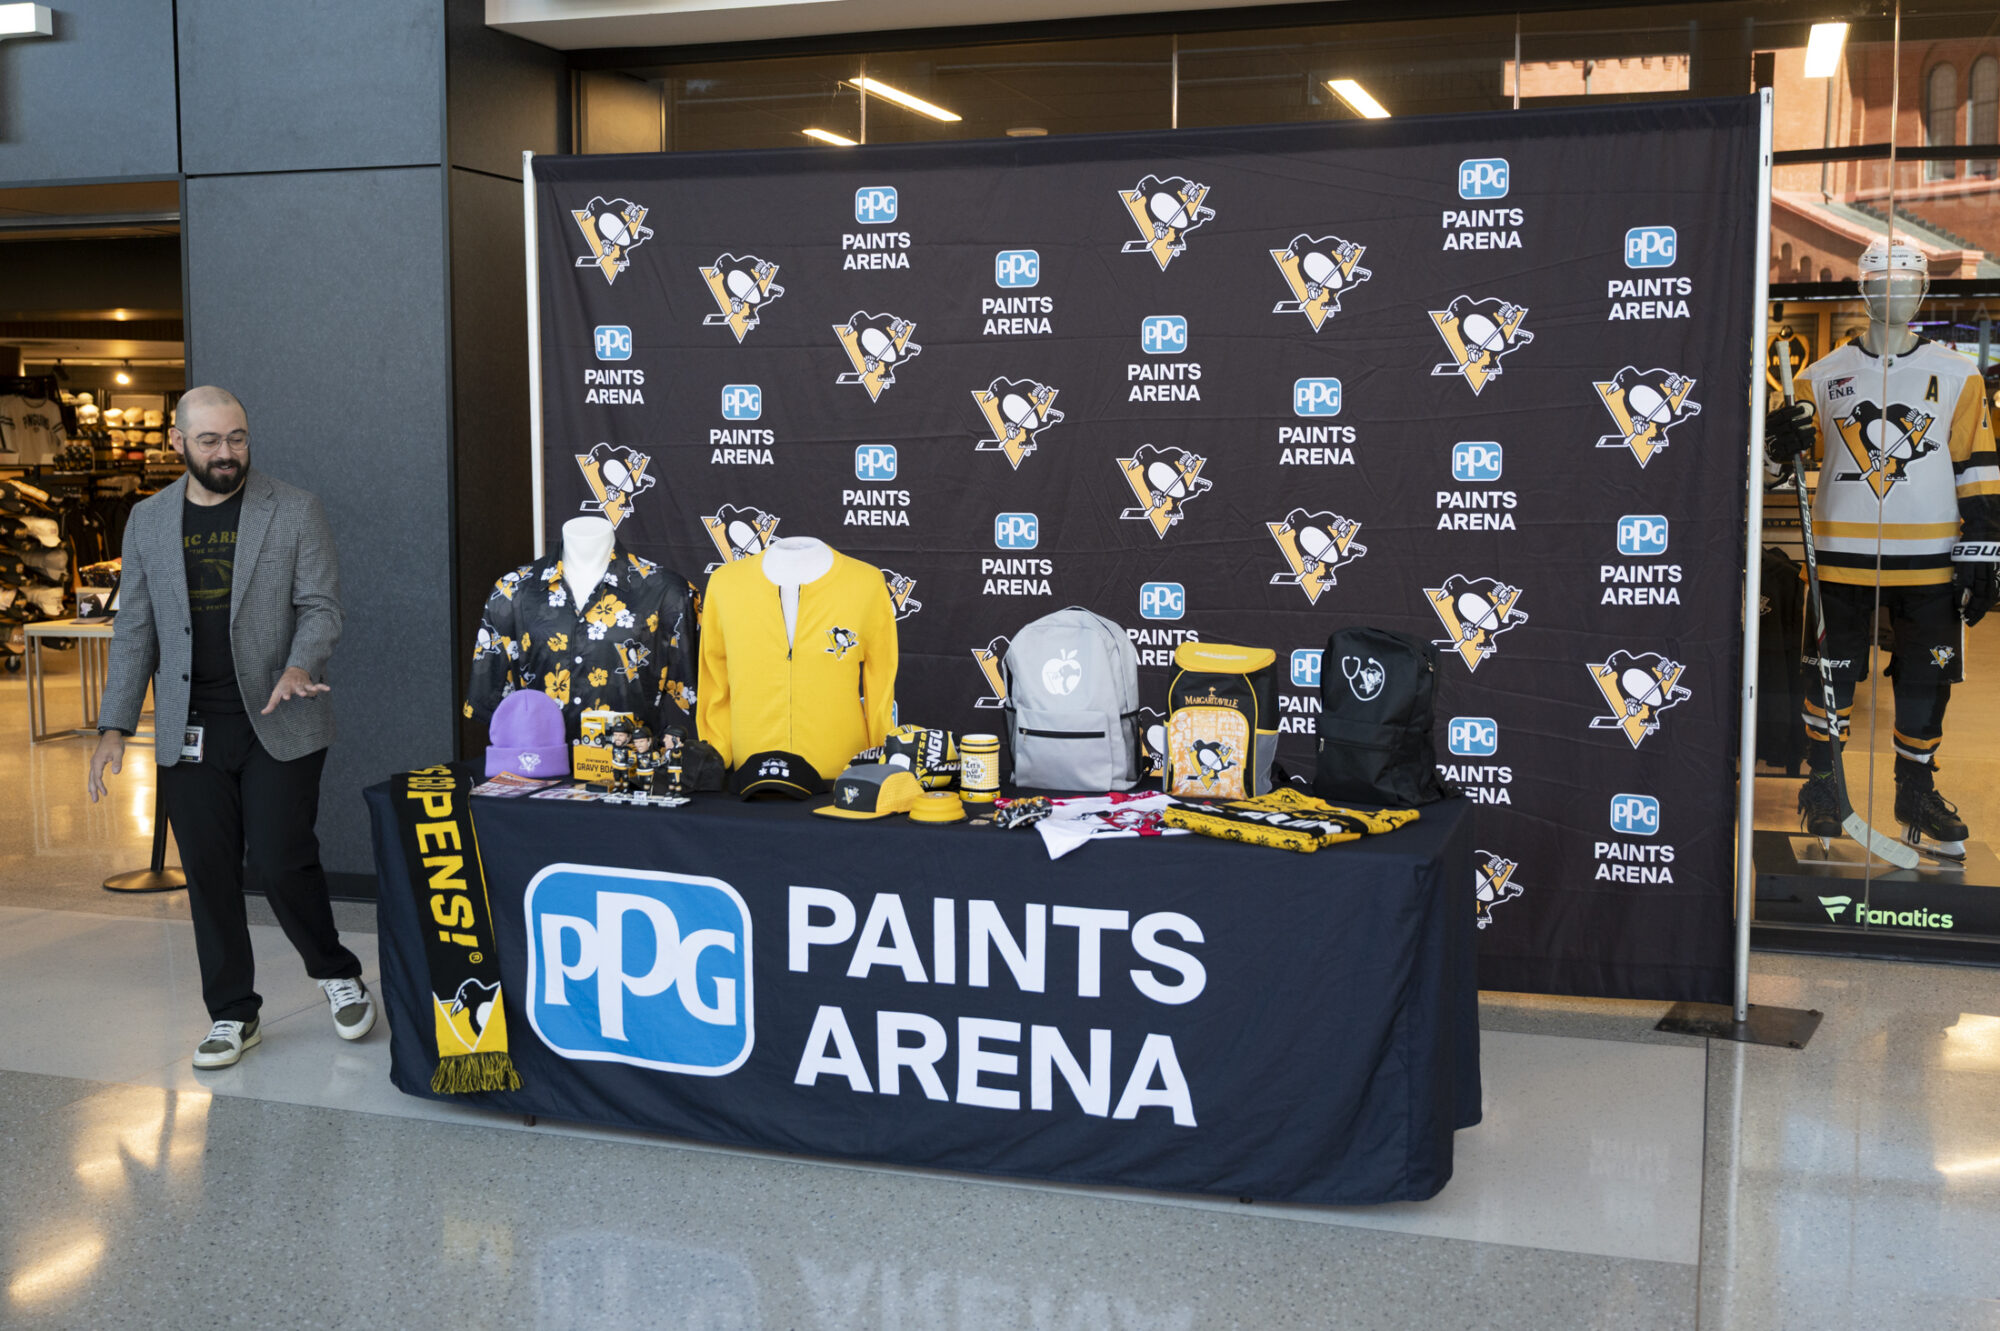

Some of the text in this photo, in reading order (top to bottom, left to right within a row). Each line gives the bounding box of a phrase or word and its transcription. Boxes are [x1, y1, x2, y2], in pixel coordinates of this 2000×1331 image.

[1462, 165, 1506, 193] PPG
[857, 190, 896, 219] PPG
[1442, 207, 1524, 228] PAINTS
[842, 231, 911, 249] PAINTS
[1442, 230, 1523, 250] ARENA
[1628, 233, 1674, 262] PPG
[843, 252, 910, 270] ARENA
[998, 256, 1037, 282] PPG
[1608, 276, 1692, 297] PAINTS
[982, 296, 1054, 314] PAINTS
[1608, 300, 1691, 320] ARENA
[982, 317, 1053, 335] ARENA
[1145, 321, 1185, 348] PPG
[596, 330, 630, 357] PPG
[584, 369, 645, 385] PAINTS
[1127, 362, 1202, 380] PAINTS
[585, 388, 645, 404] ARENA
[1128, 384, 1201, 401] ARENA
[1296, 382, 1339, 412] PPG
[1925, 375, 1939, 403] A
[723, 388, 760, 416] PPG
[709, 429, 775, 444] PAINTS
[1278, 426, 1357, 443] PAINTS
[711, 448, 775, 464] ARENA
[858, 450, 894, 475] PPG
[1279, 447, 1355, 464] ARENA
[1455, 448, 1499, 475] PPG
[842, 489, 911, 506] PAINTS
[1436, 491, 1518, 508] PAINTS
[843, 509, 910, 526] ARENA
[1436, 513, 1516, 530] ARENA
[1797, 473, 1816, 568] JETSPEED
[997, 517, 1037, 546] PPG
[1620, 521, 1665, 549] PPG
[981, 558, 1053, 575] PAINTS
[1600, 564, 1682, 582] PAINTS
[982, 578, 1052, 595] ARENA
[1600, 587, 1681, 604] ARENA
[1142, 588, 1182, 614] PPG
[1294, 654, 1321, 682] PP
[1278, 695, 1322, 713] PAIN
[1820, 658, 1840, 737] CCM
[1277, 716, 1316, 733] ARE
[1451, 723, 1494, 750] PPG
[576, 763, 614, 773] GRAVY BOA
[1614, 800, 1656, 827] PPG
[1594, 842, 1675, 862] PAINTS
[407, 791, 479, 948] PENS!
[1595, 863, 1674, 883] ARENA
[1855, 903, 1954, 929] Fanatics
[789, 886, 1206, 1004] PAINTS
[541, 892, 736, 1041] PPG
[794, 1005, 1196, 1126] ARENA
